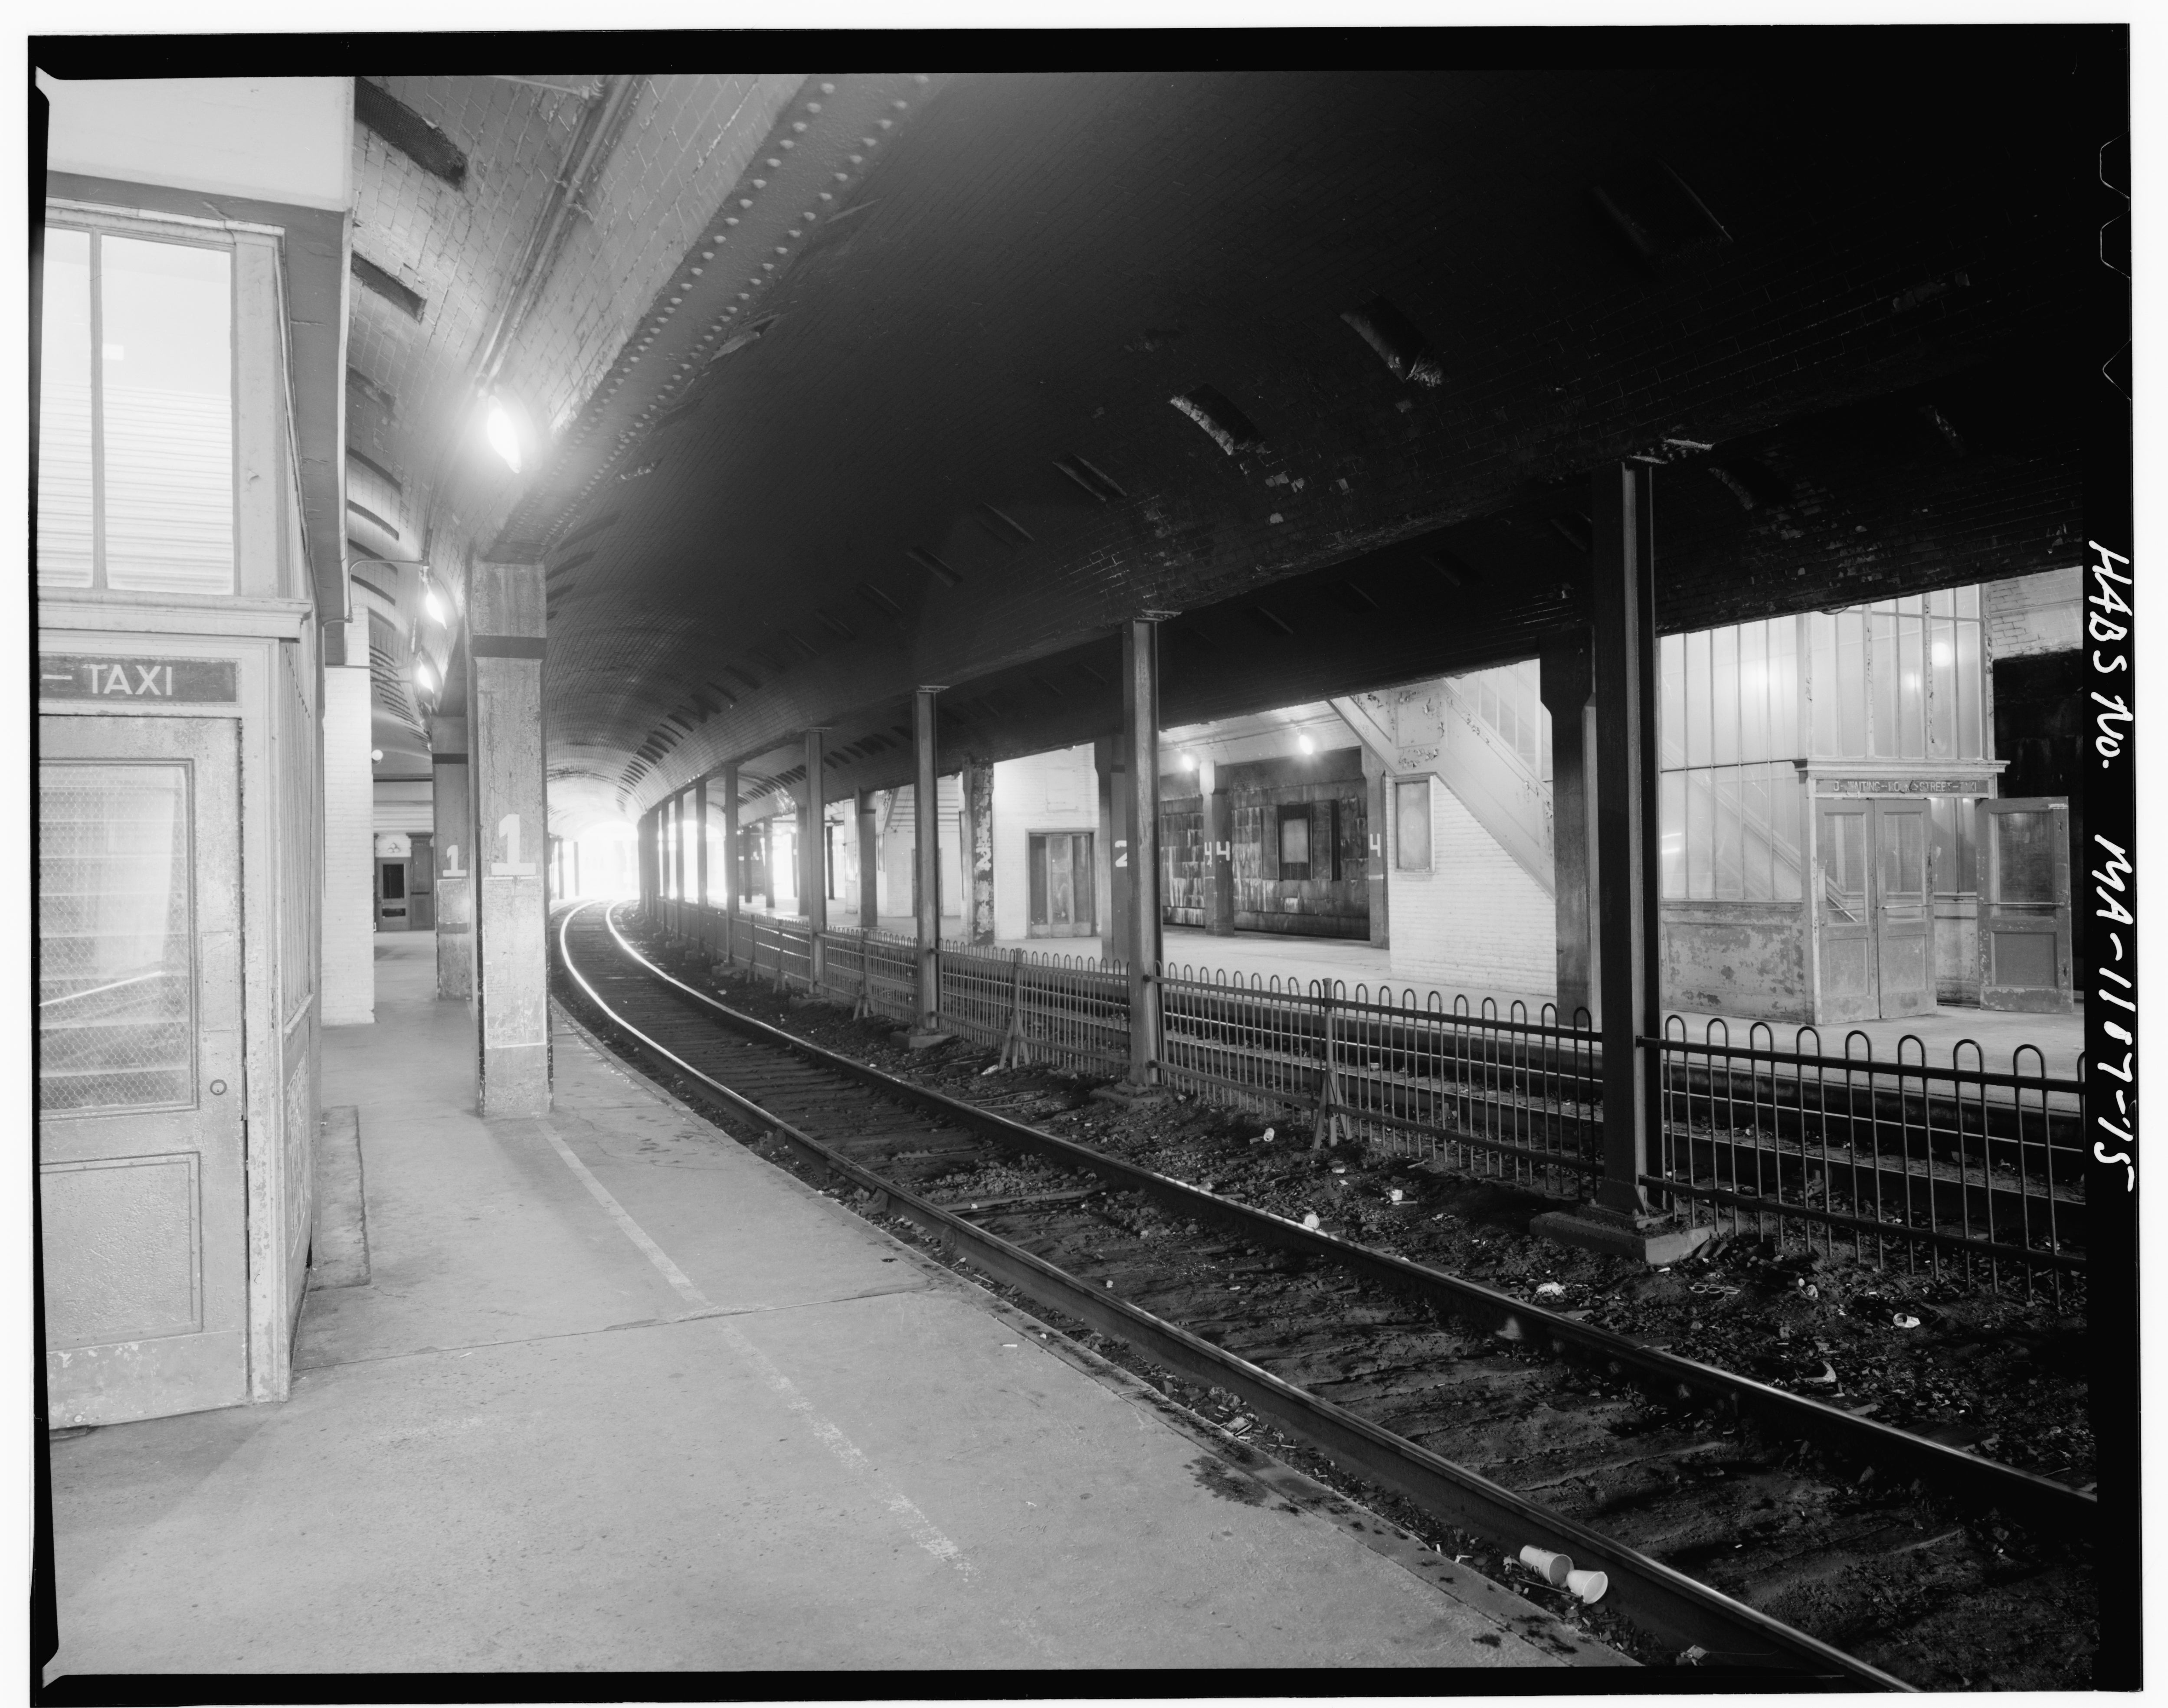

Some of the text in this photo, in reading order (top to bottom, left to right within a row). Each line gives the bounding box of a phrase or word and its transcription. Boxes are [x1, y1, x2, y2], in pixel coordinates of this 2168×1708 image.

[82, 664, 173, 696] TAXI
[491, 814, 537, 876] 1
[976, 847, 992, 871] 2
[1216, 841, 1230, 861] 4
[1369, 833, 1381, 857] 4
[442, 845, 467, 877] 1
